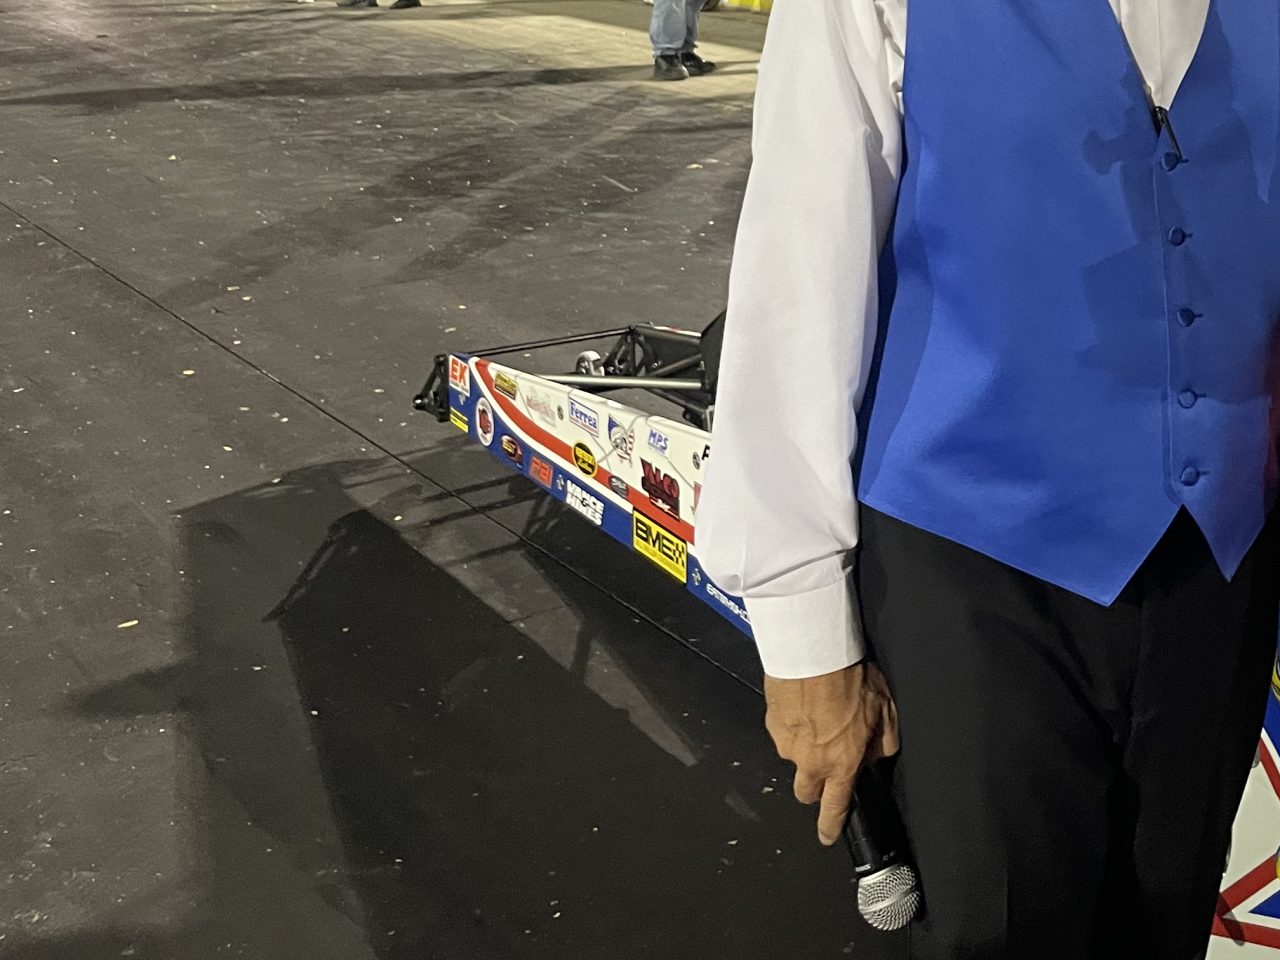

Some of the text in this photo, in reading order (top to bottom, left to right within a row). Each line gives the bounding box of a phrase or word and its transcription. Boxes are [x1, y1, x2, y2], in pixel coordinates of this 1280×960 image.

[451, 358, 468, 386] EK
[569, 401, 598, 430] Ferrea
[649, 428, 669, 448] MPS
